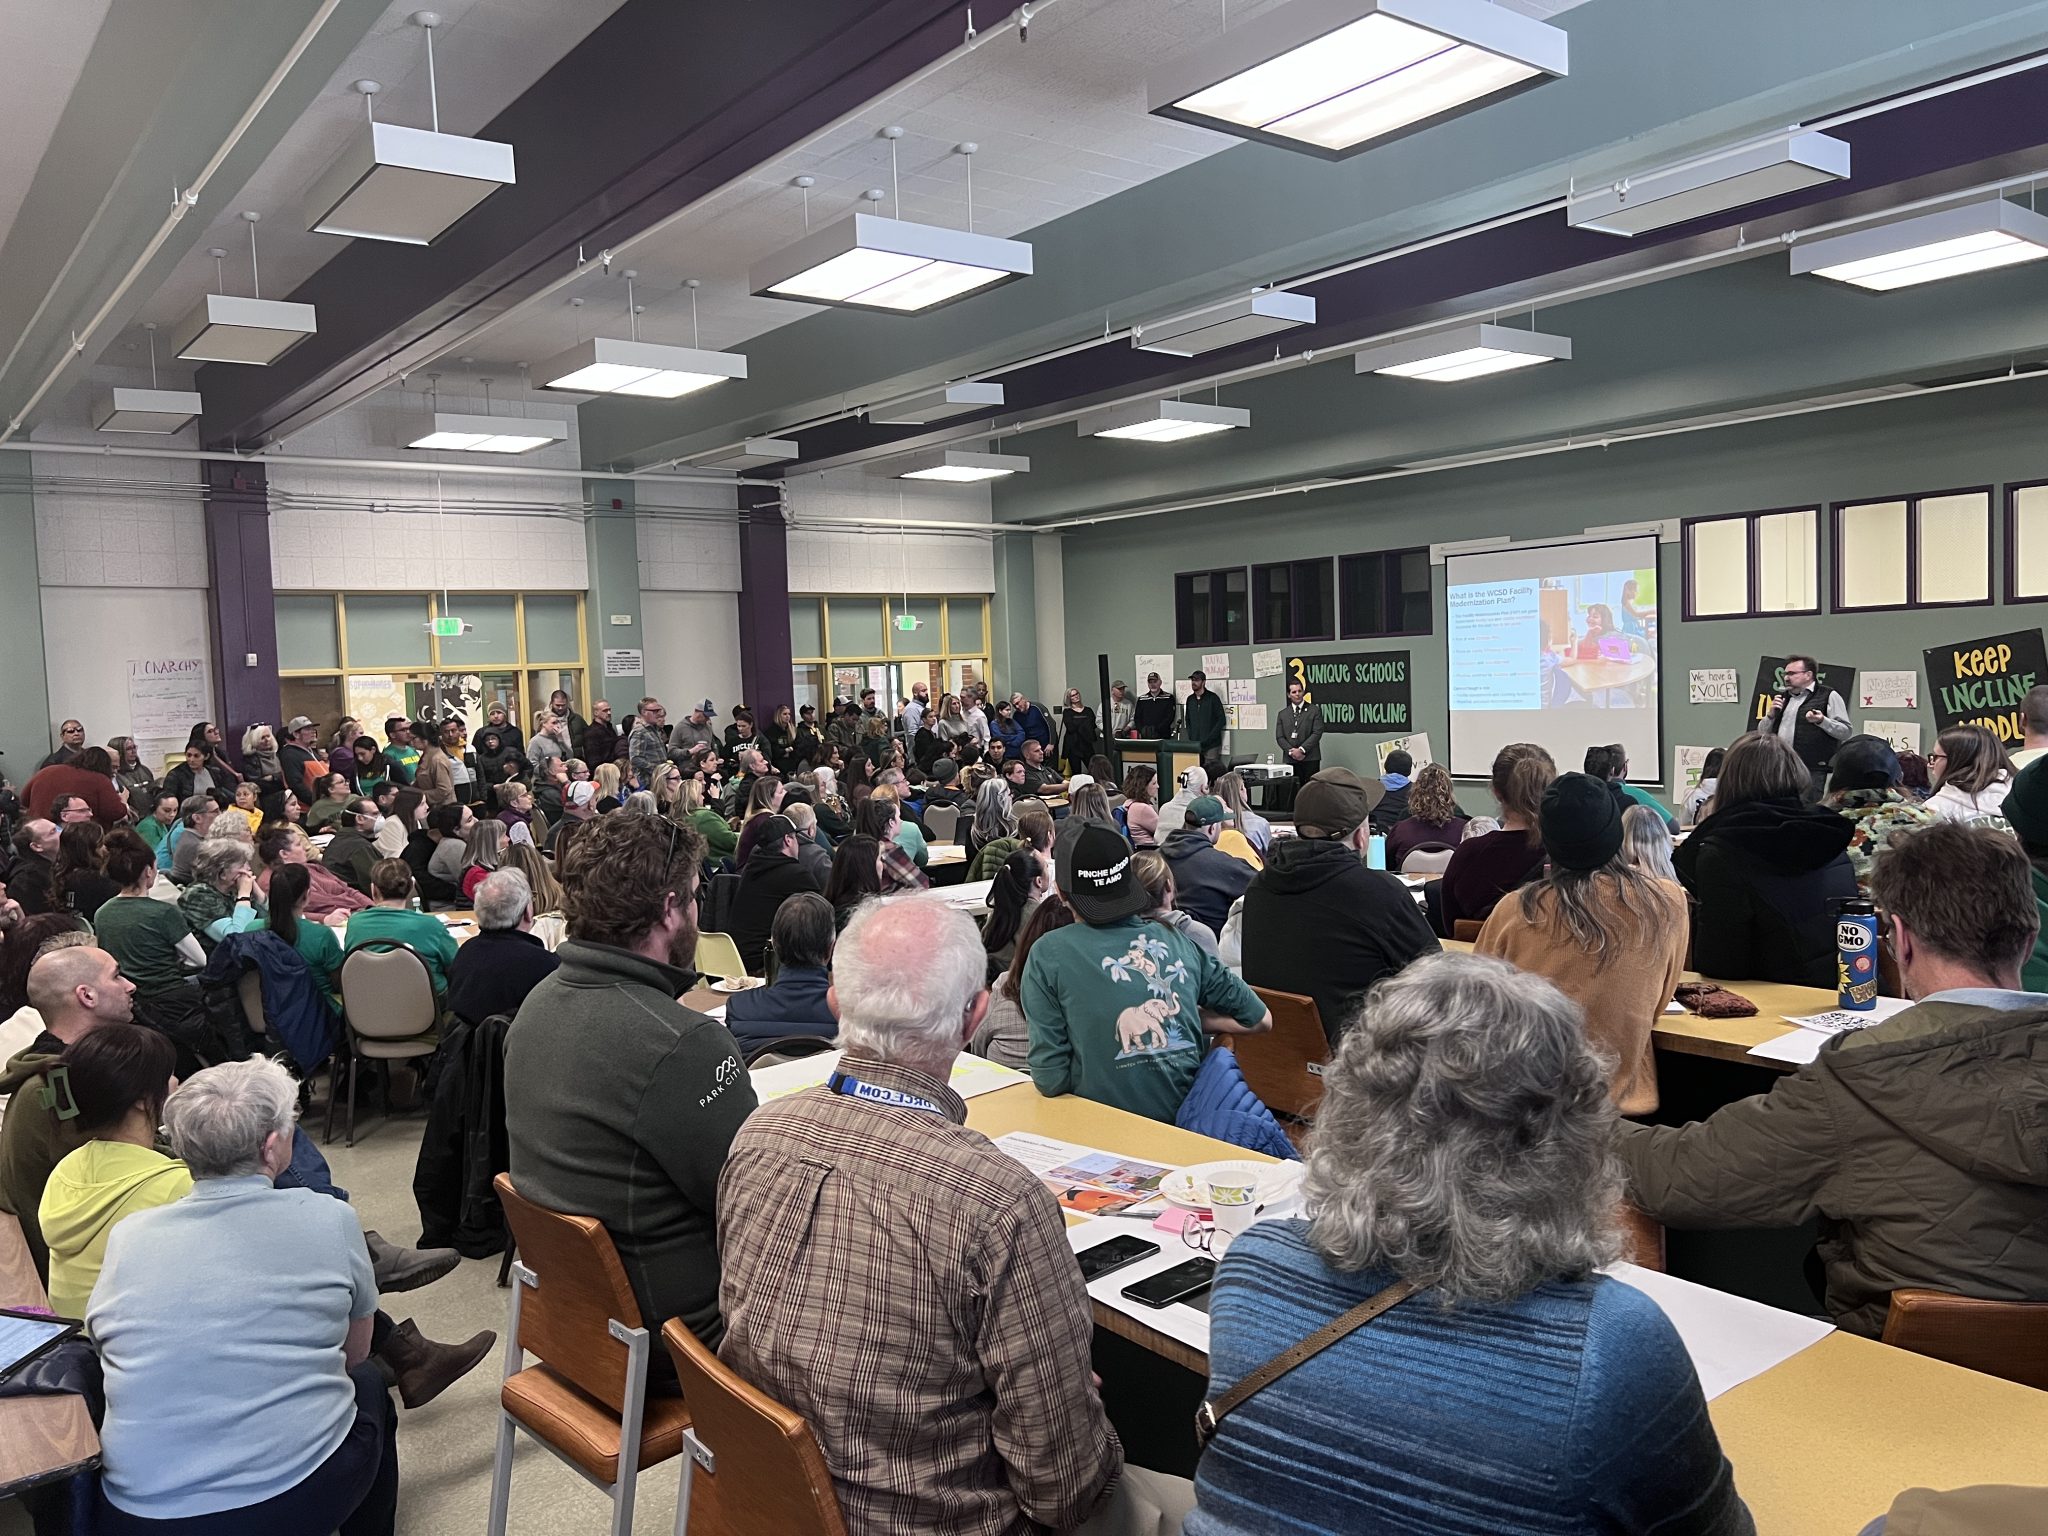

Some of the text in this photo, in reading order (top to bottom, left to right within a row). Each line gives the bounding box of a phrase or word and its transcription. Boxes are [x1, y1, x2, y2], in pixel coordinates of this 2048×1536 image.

[1450, 592, 1467, 600] What
[1487, 588, 1508, 597] WCSD
[1450, 598, 1495, 608] Modernization
[1355, 661, 1405, 683] SCHOOLS
[1690, 671, 1705, 682] We
[1708, 670, 1726, 682] have
[1077, 869, 1109, 879] PINCHE
[1093, 872, 1122, 888] TE AMO
[1840, 925, 1859, 936] NO
[1838, 934, 1865, 947] GMO
[699, 1084, 726, 1108] PARK
